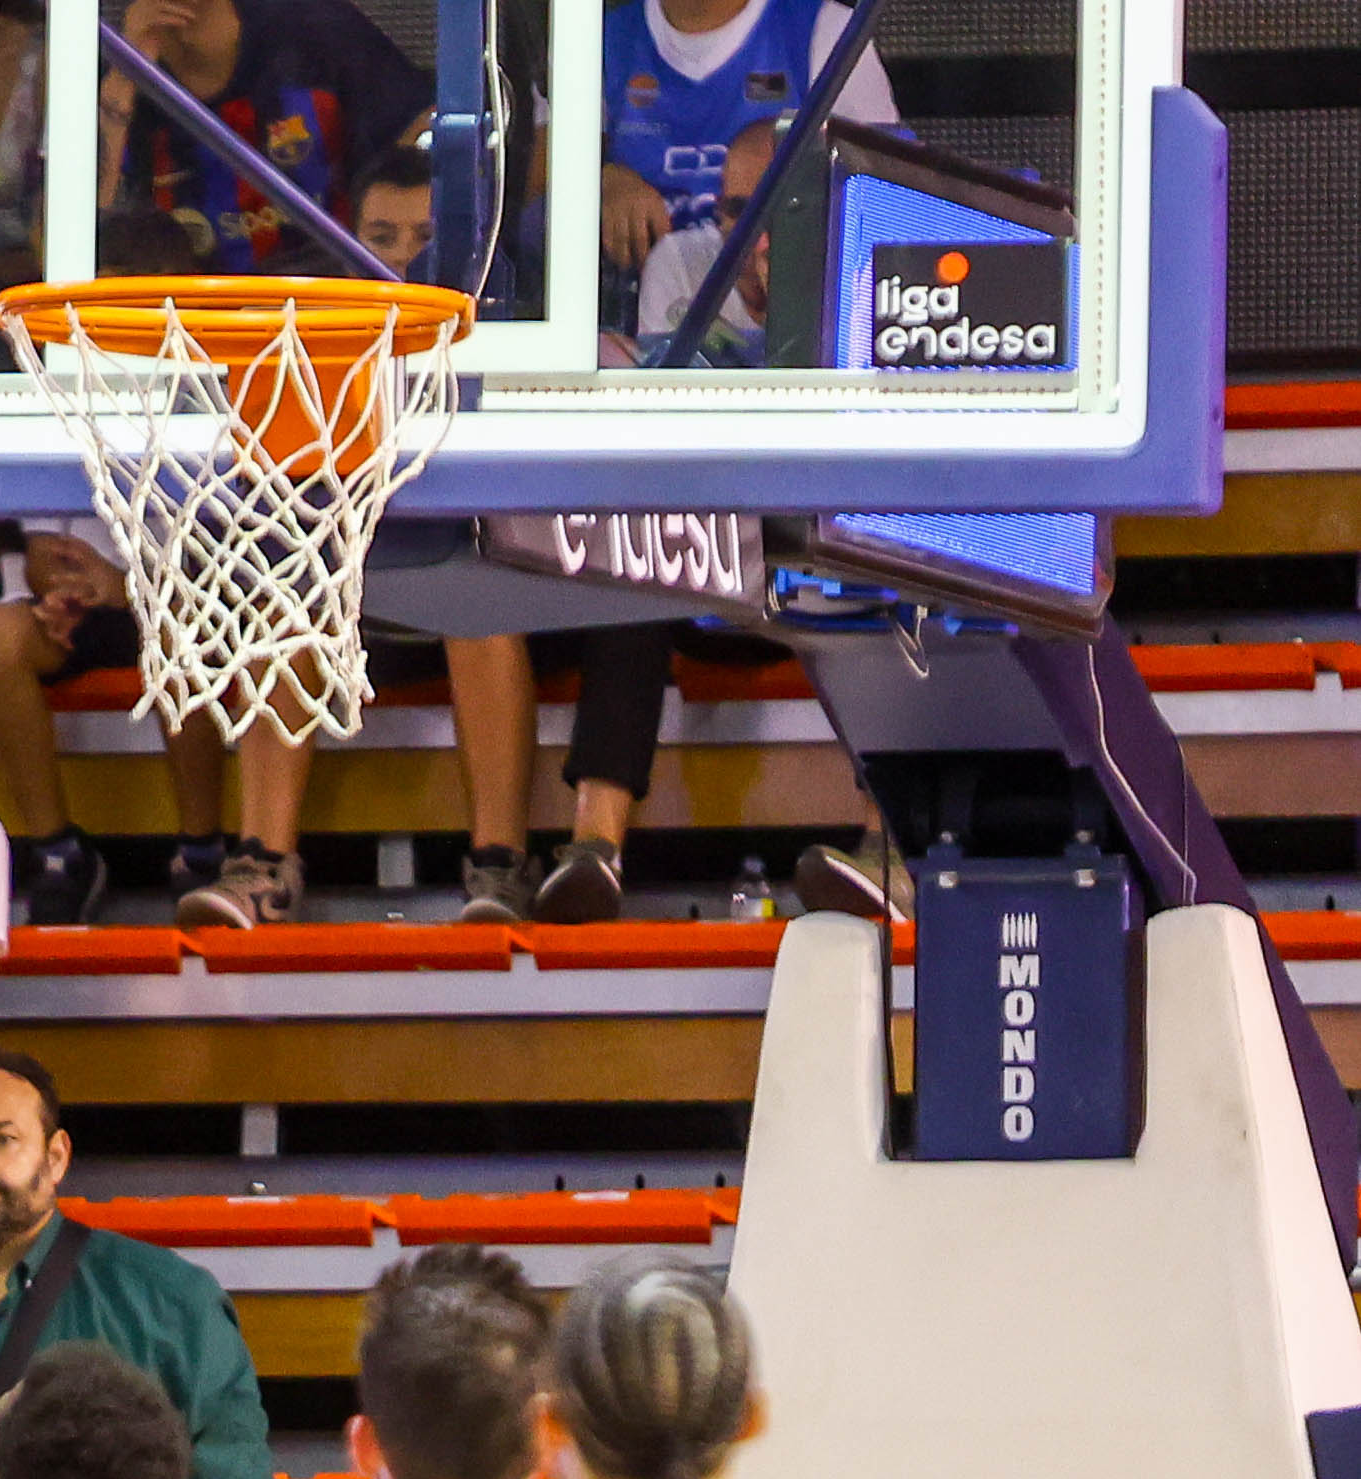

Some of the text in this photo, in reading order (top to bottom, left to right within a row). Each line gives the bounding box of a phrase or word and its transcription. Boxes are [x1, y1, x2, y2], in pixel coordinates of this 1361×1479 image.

[876, 274, 960, 326] liga
[877, 316, 1057, 363] endesa
[999, 955, 1040, 1142] MONDO
